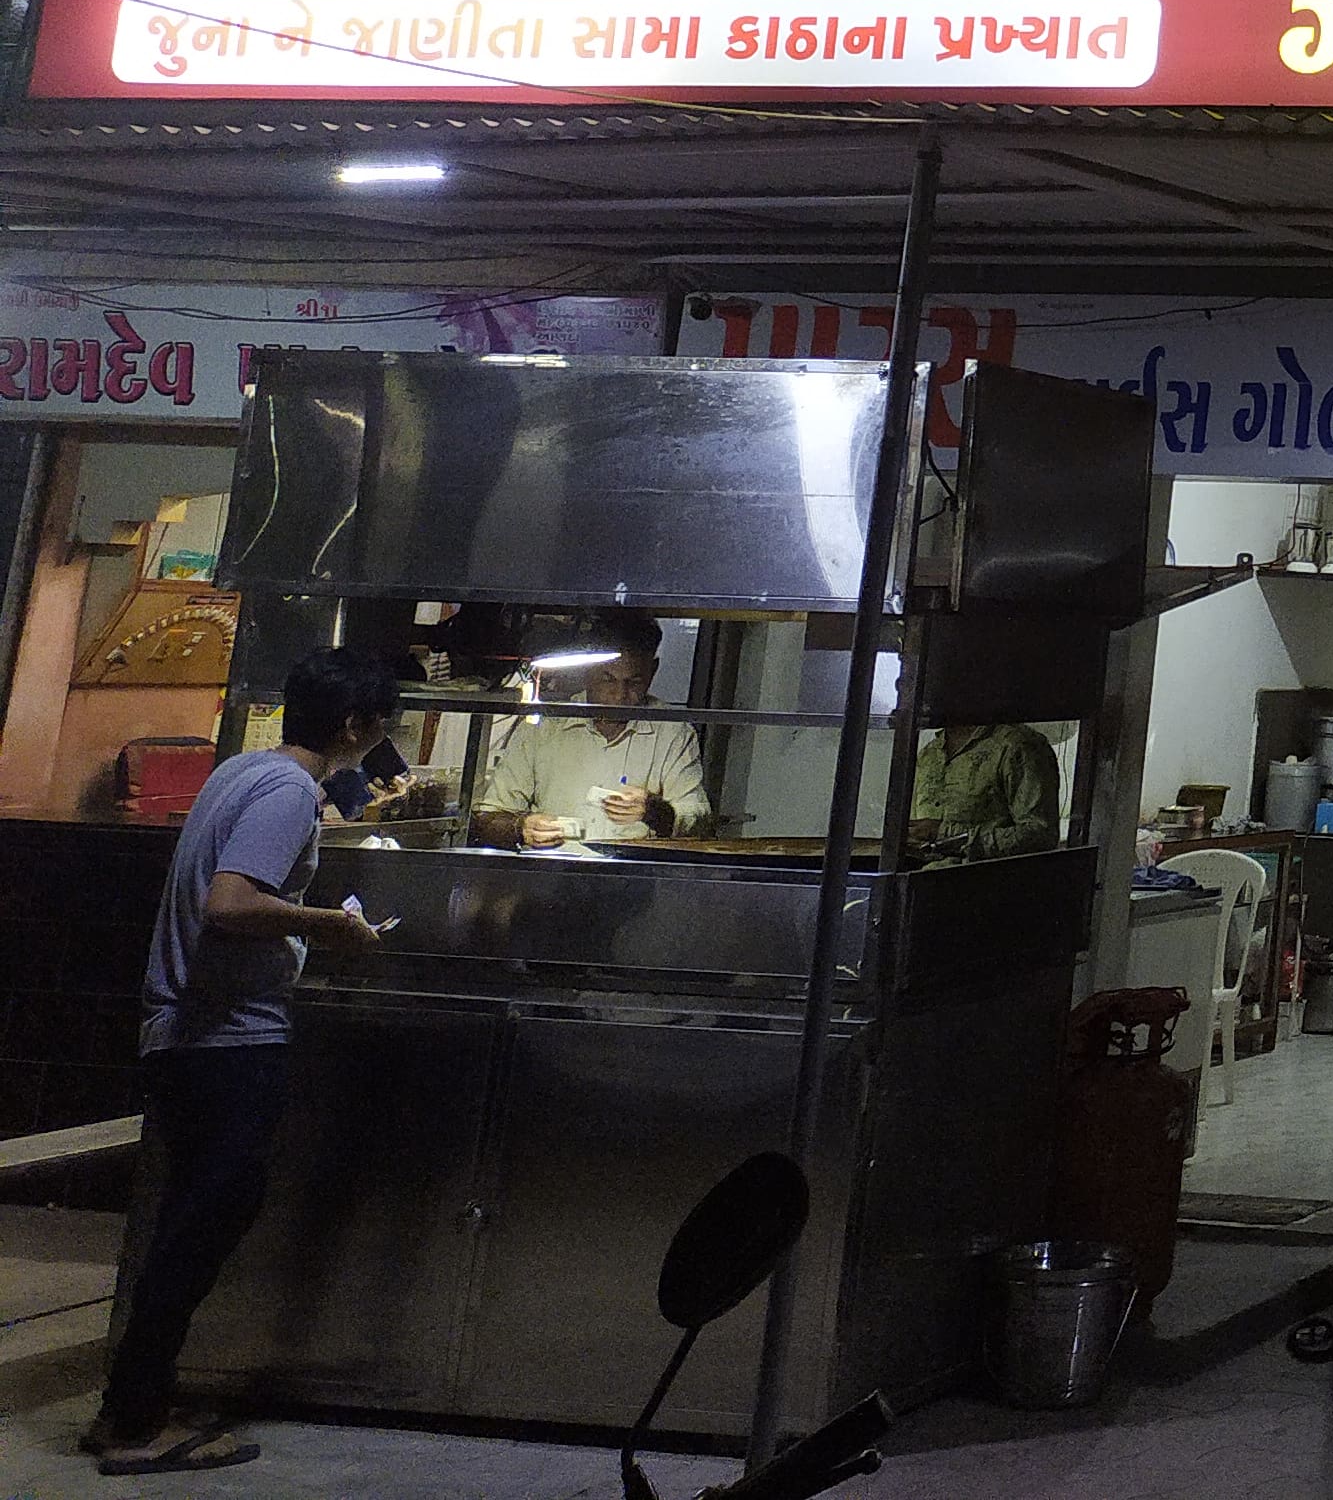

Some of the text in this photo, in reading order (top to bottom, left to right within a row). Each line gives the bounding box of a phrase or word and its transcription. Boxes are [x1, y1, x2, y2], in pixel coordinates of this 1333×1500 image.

[571, 15, 699, 60] સામા
[723, 15, 907, 61] કાઠાના
[934, 15, 1129, 61] પ્રખ્યાત
[0, 311, 196, 406] રામદેવ
